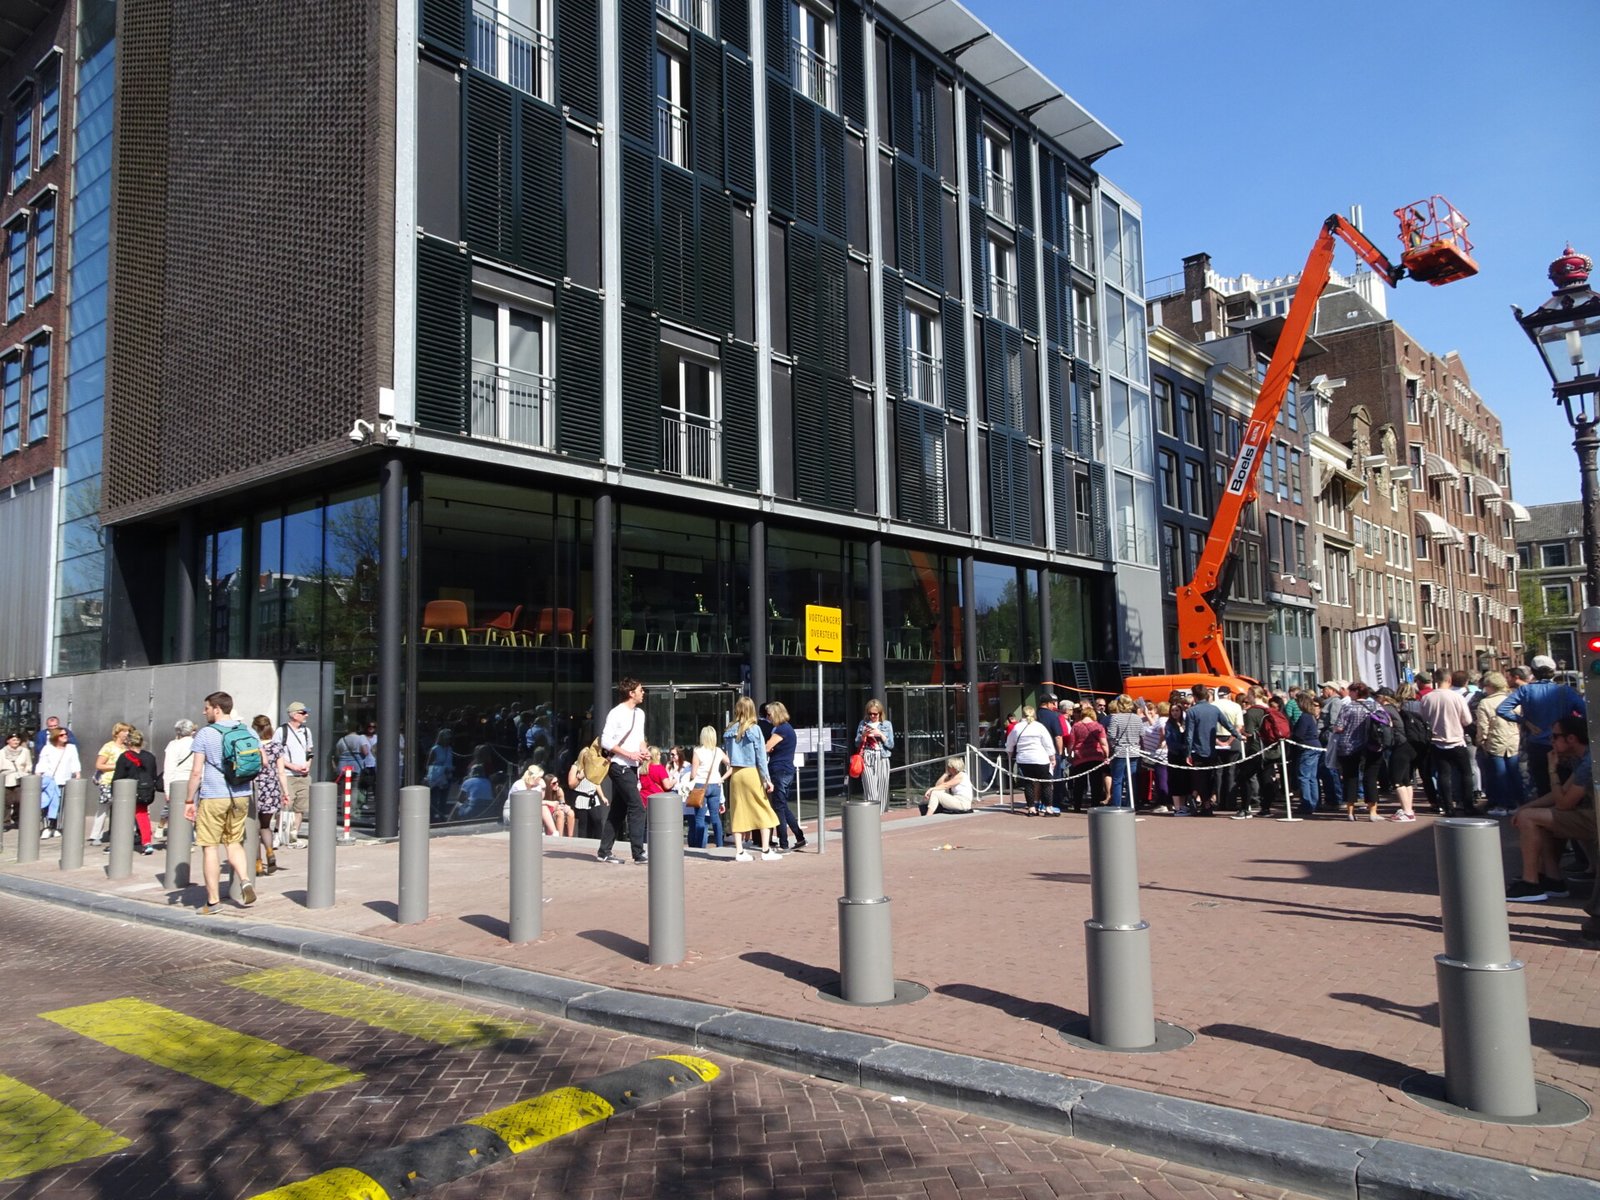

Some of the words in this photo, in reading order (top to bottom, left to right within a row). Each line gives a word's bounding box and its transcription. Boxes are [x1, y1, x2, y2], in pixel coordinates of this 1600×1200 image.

[1230, 447, 1254, 492] Boels
[808, 613, 841, 625] VOETGANGERS
[810, 628, 839, 640] OVERSTEKEN
